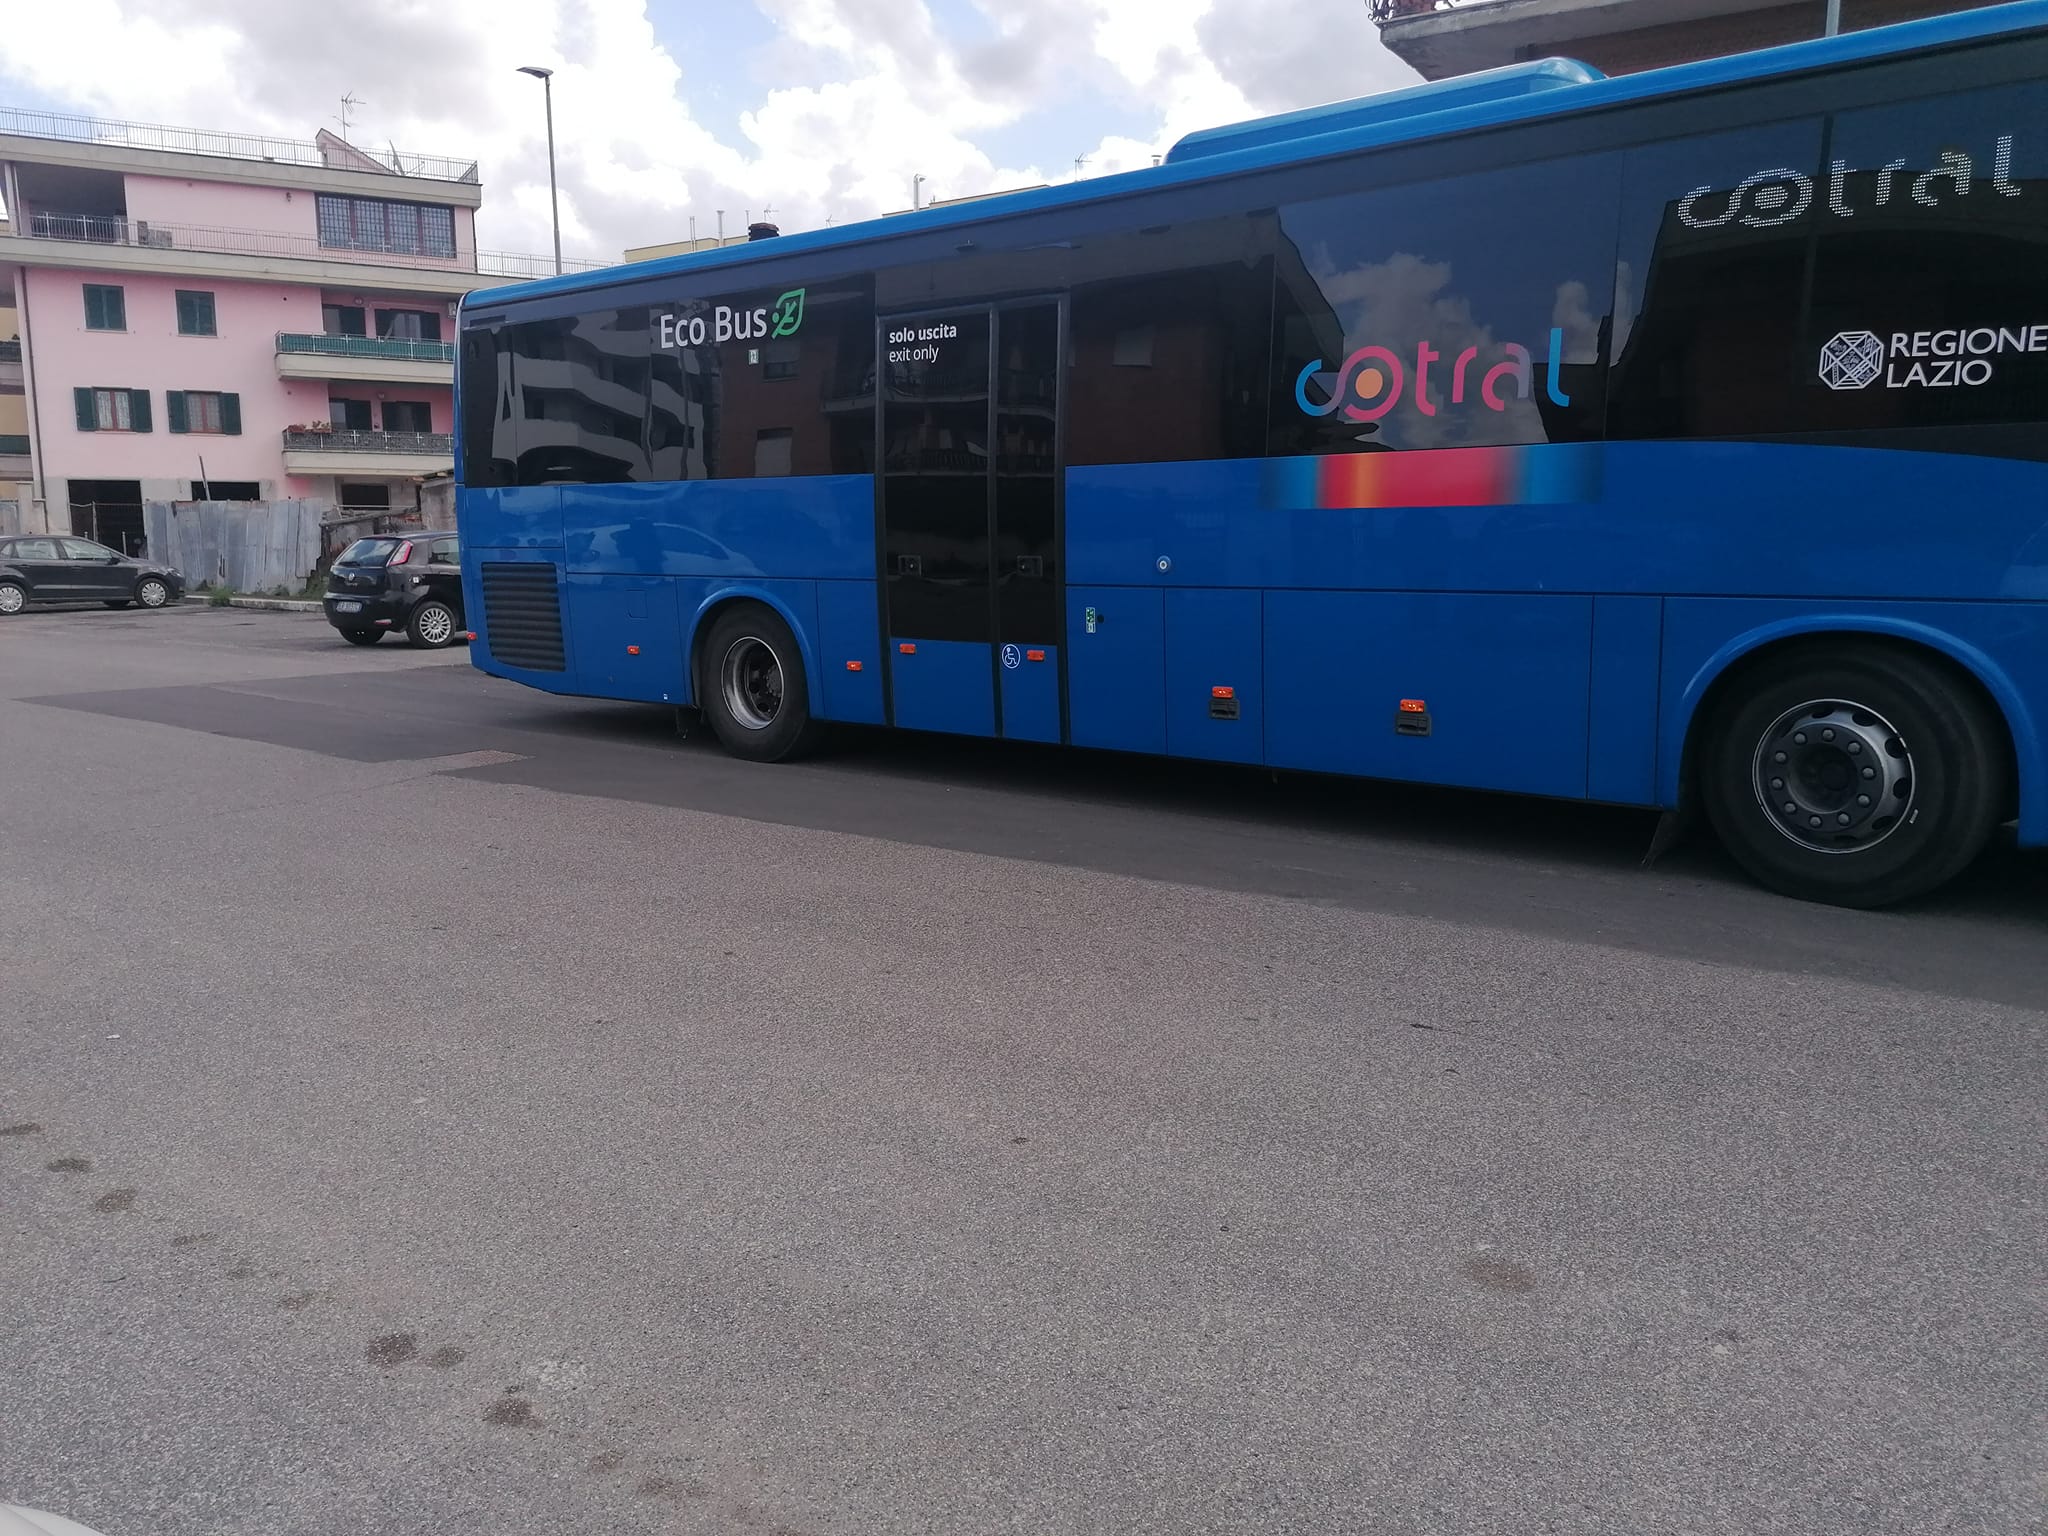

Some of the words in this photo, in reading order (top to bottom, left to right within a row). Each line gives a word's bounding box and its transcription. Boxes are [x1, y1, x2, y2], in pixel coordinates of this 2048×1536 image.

[1678, 135, 2022, 228] cotral
[660, 314, 706, 349] Eco
[715, 305, 768, 342] Bus
[889, 327, 915, 343] solo
[918, 323, 957, 340] uscita
[1890, 325, 2048, 358] REGIONE
[889, 347, 911, 362] exit
[913, 344, 939, 363] only
[1295, 327, 1570, 421] cotral
[1886, 359, 1992, 388] LAZIO
